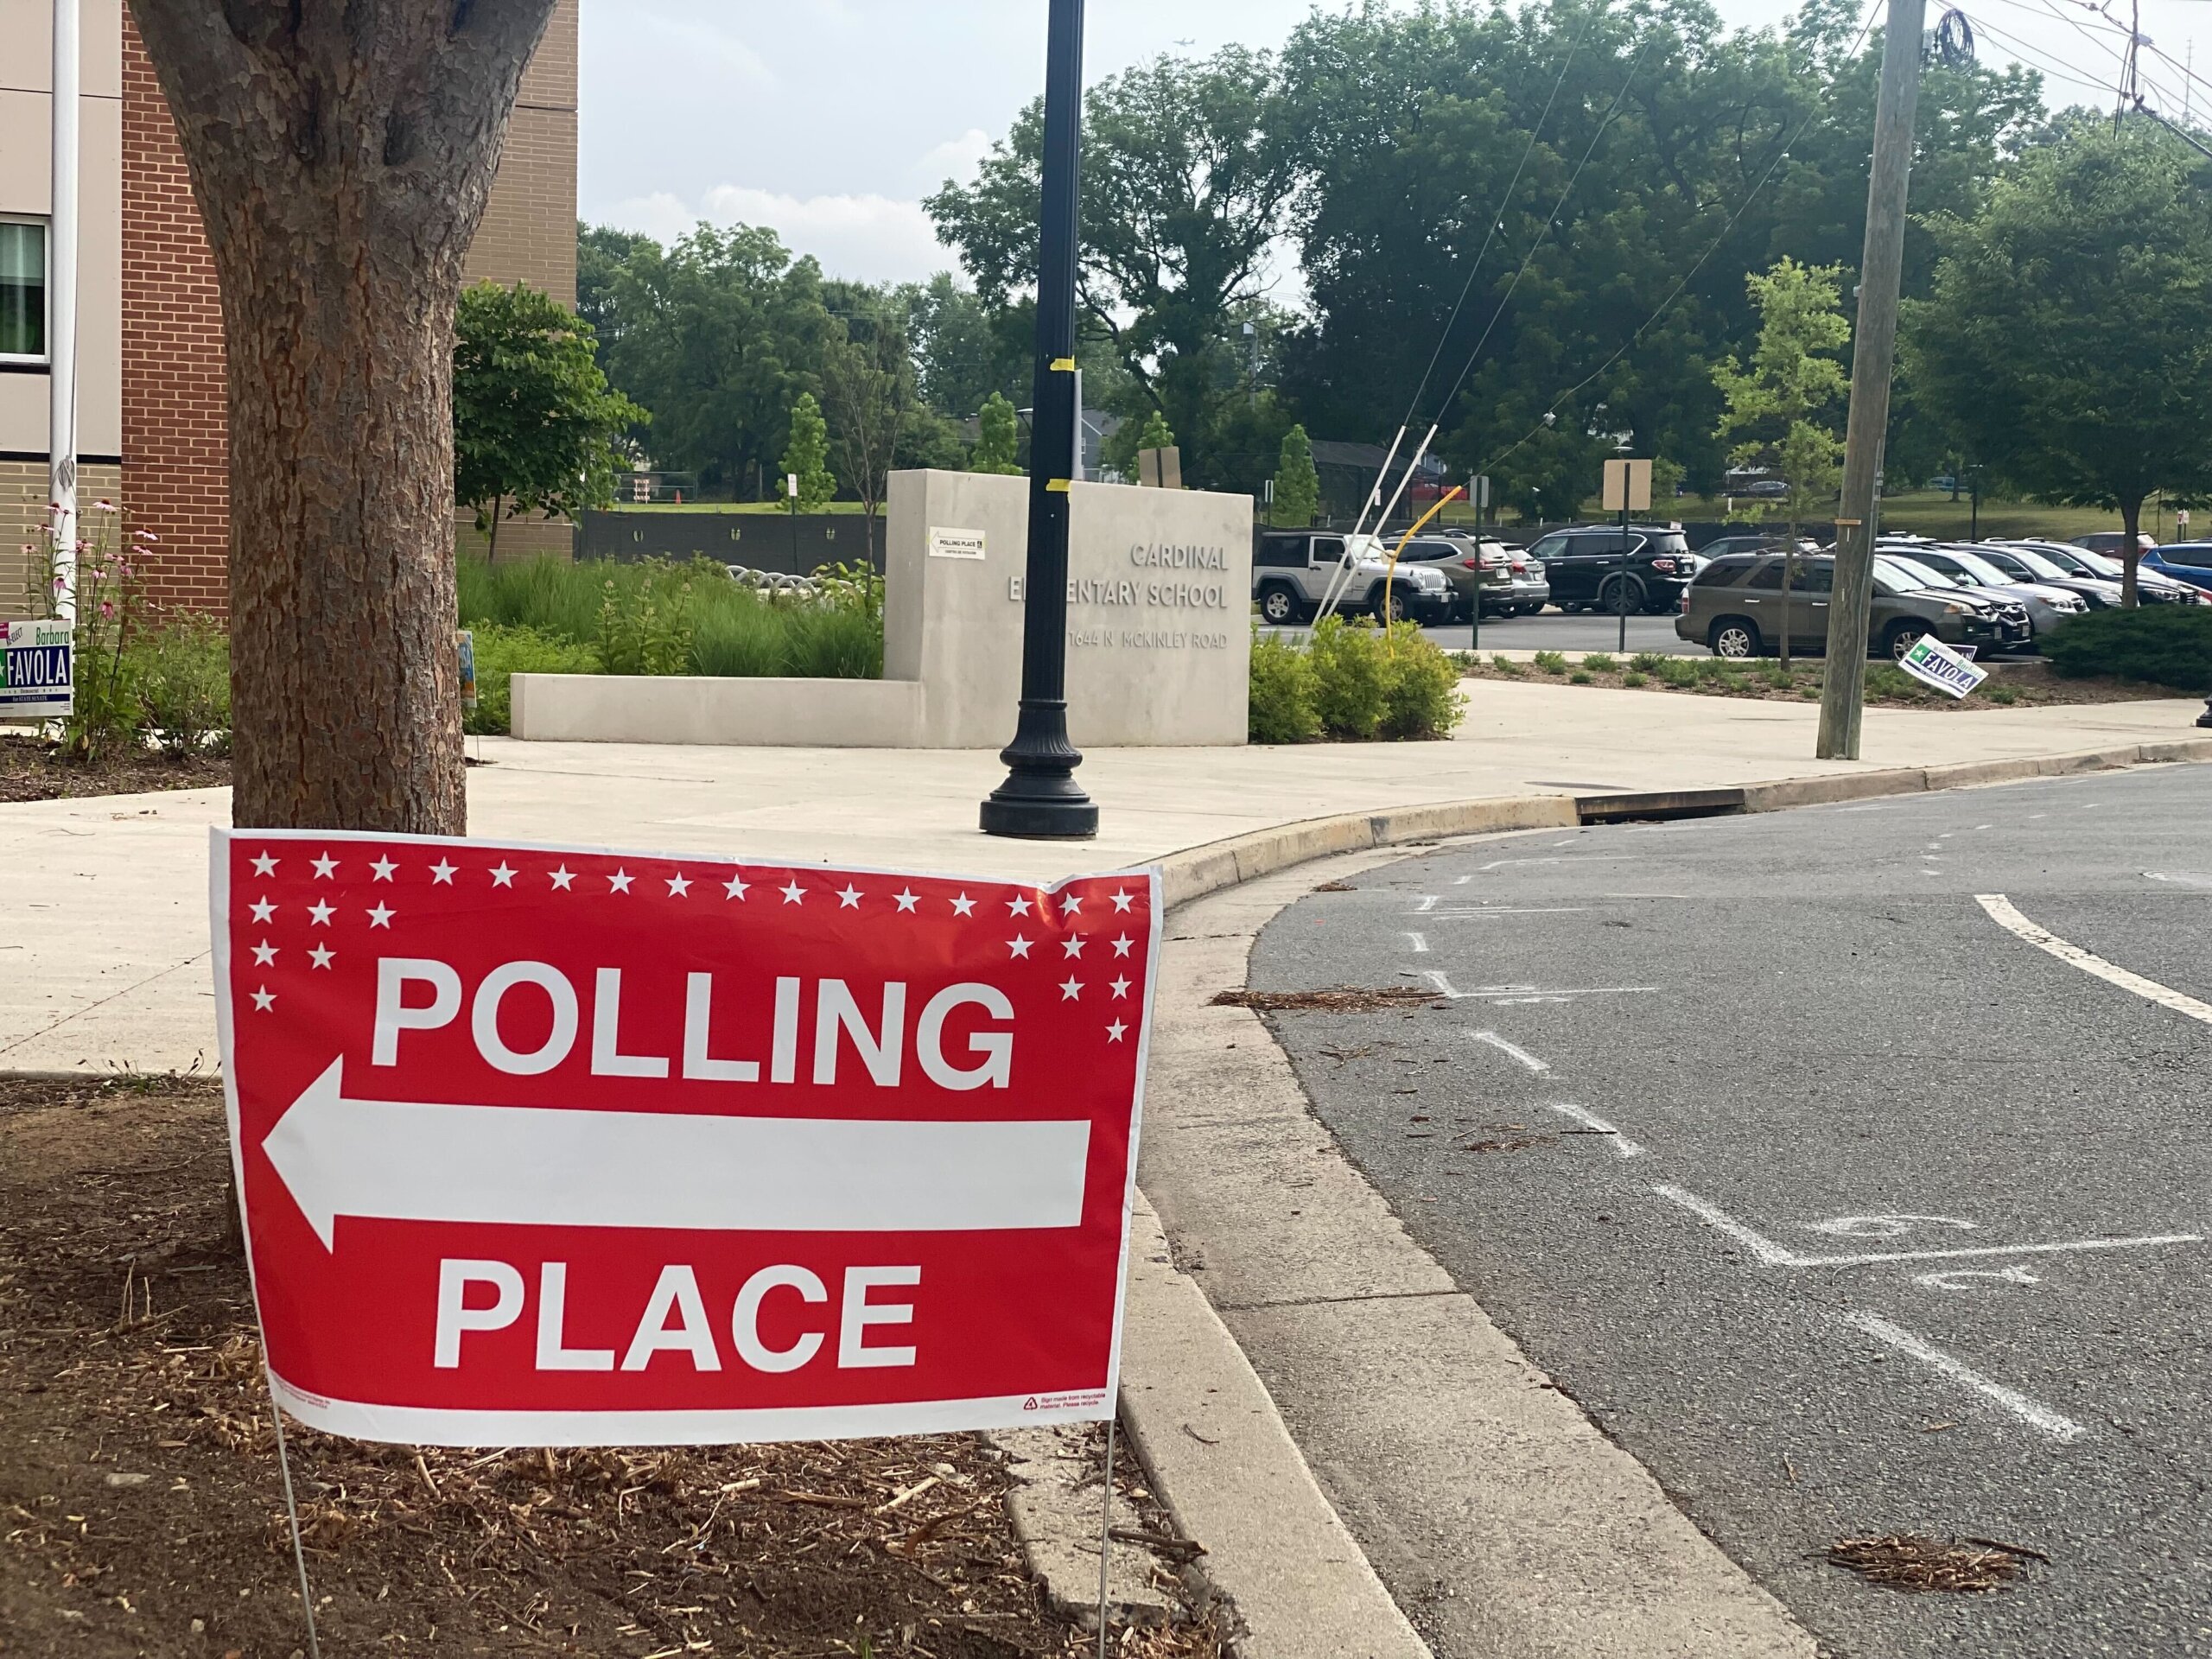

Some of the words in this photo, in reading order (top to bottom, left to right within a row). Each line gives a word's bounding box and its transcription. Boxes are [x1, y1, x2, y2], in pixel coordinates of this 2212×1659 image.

[1129, 543, 1229, 571] CARDINAL
[1008, 575, 1141, 606] EENTARY
[1147, 582, 1228, 608] SCHOOL
[35, 624, 69, 645] Barbara
[1069, 630, 1098, 646] 1644
[1103, 631, 1113, 647] N
[1122, 631, 1187, 648] MCKINLEY
[1192, 632, 1227, 649] ROAD
[7, 649, 67, 686] FAVOLA
[1921, 651, 1974, 689] FAVOLA
[372, 957, 1014, 1090] POLLING
[434, 1258, 922, 1373] PLACE
